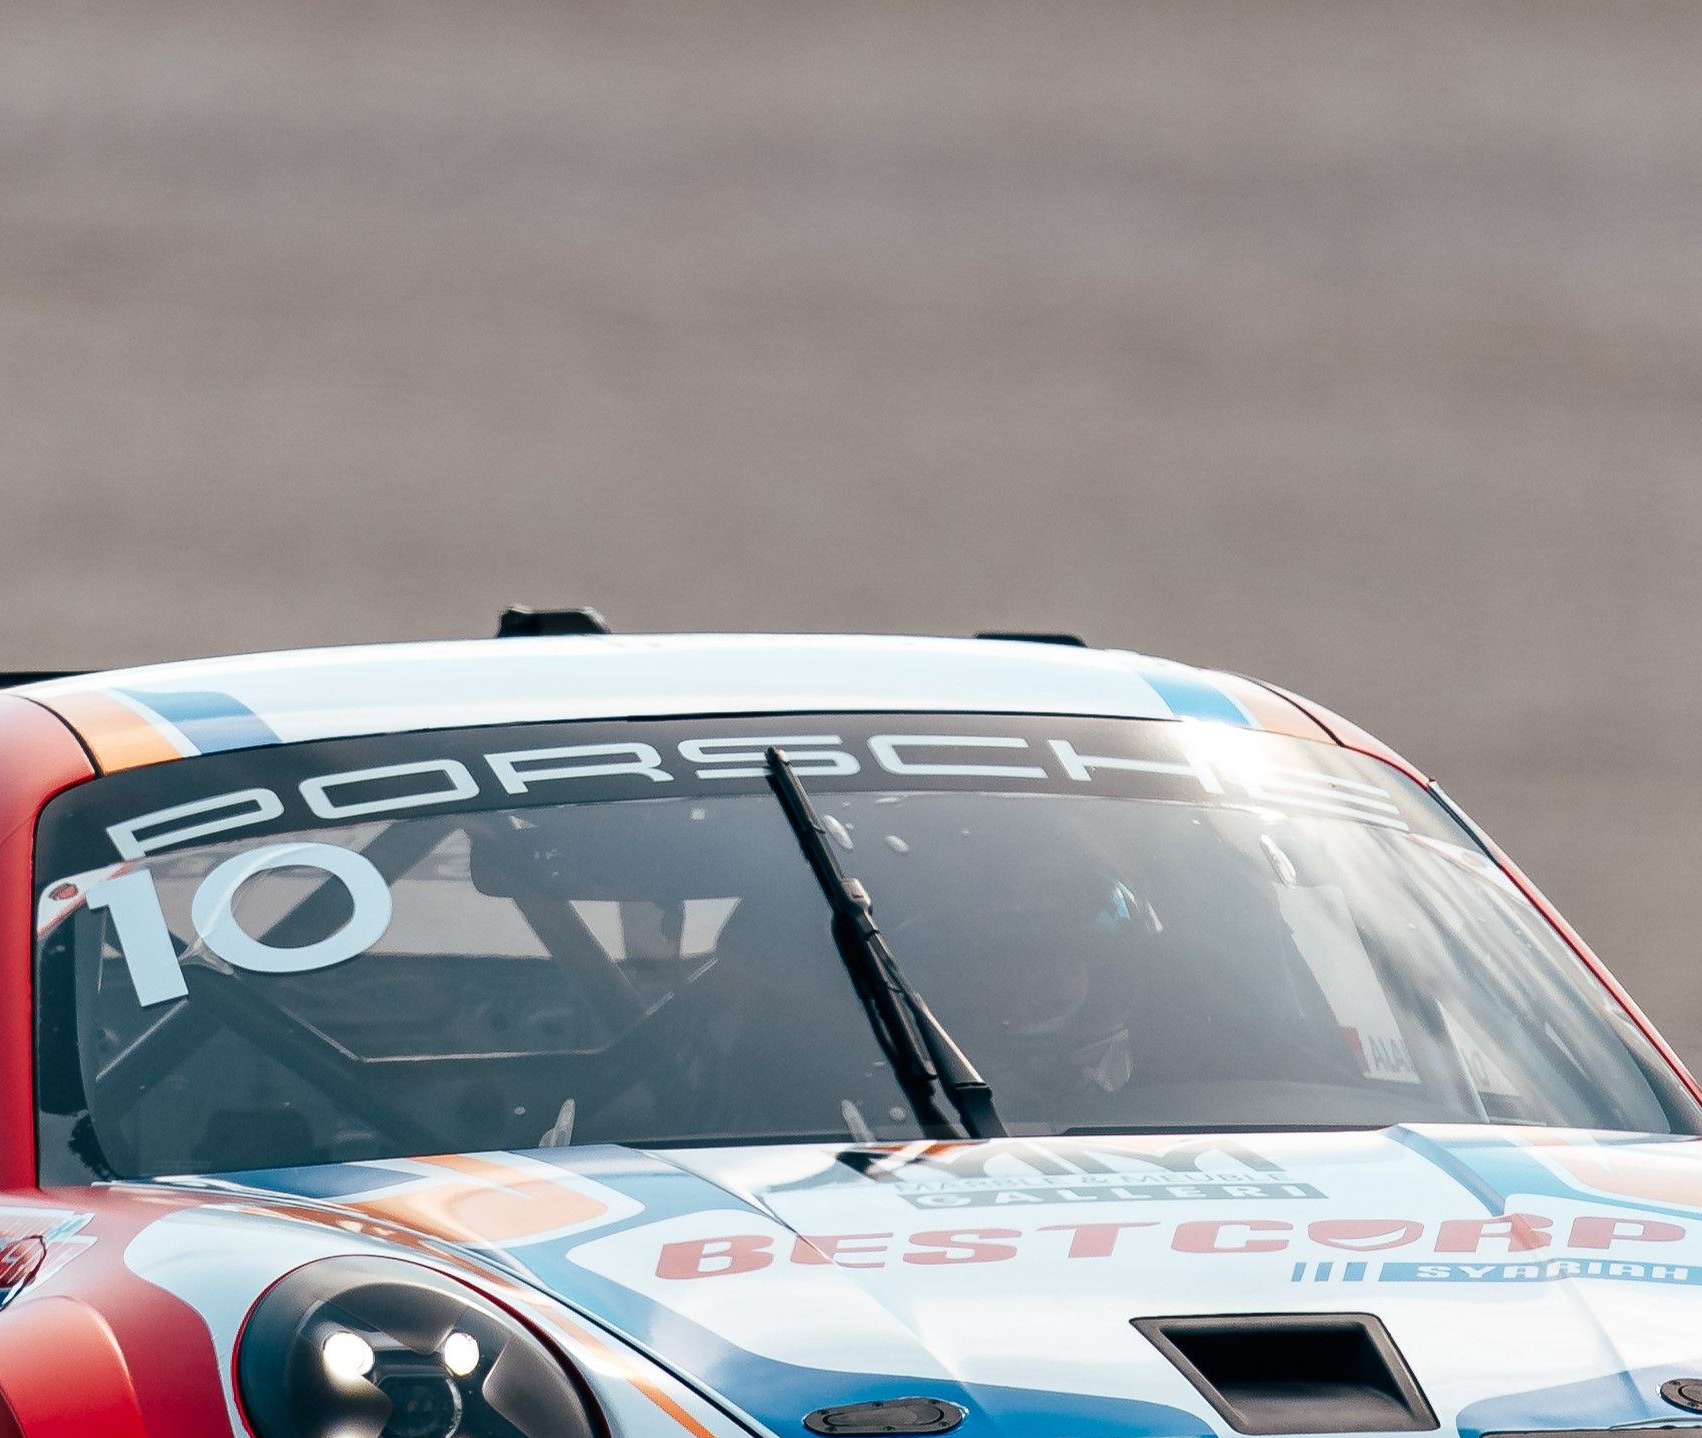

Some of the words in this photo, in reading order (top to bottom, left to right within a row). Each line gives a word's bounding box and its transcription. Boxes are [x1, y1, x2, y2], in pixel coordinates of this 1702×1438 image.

[105, 735, 1410, 860] PORSCHE
[88, 841, 392, 1008] 10
[916, 1184, 1308, 1208] GALLERI
[1122, 1172, 1294, 1183] MEUBLE
[655, 1213, 1686, 1280] BESTCORP
[1416, 1259, 1688, 1281] SYARIAH
